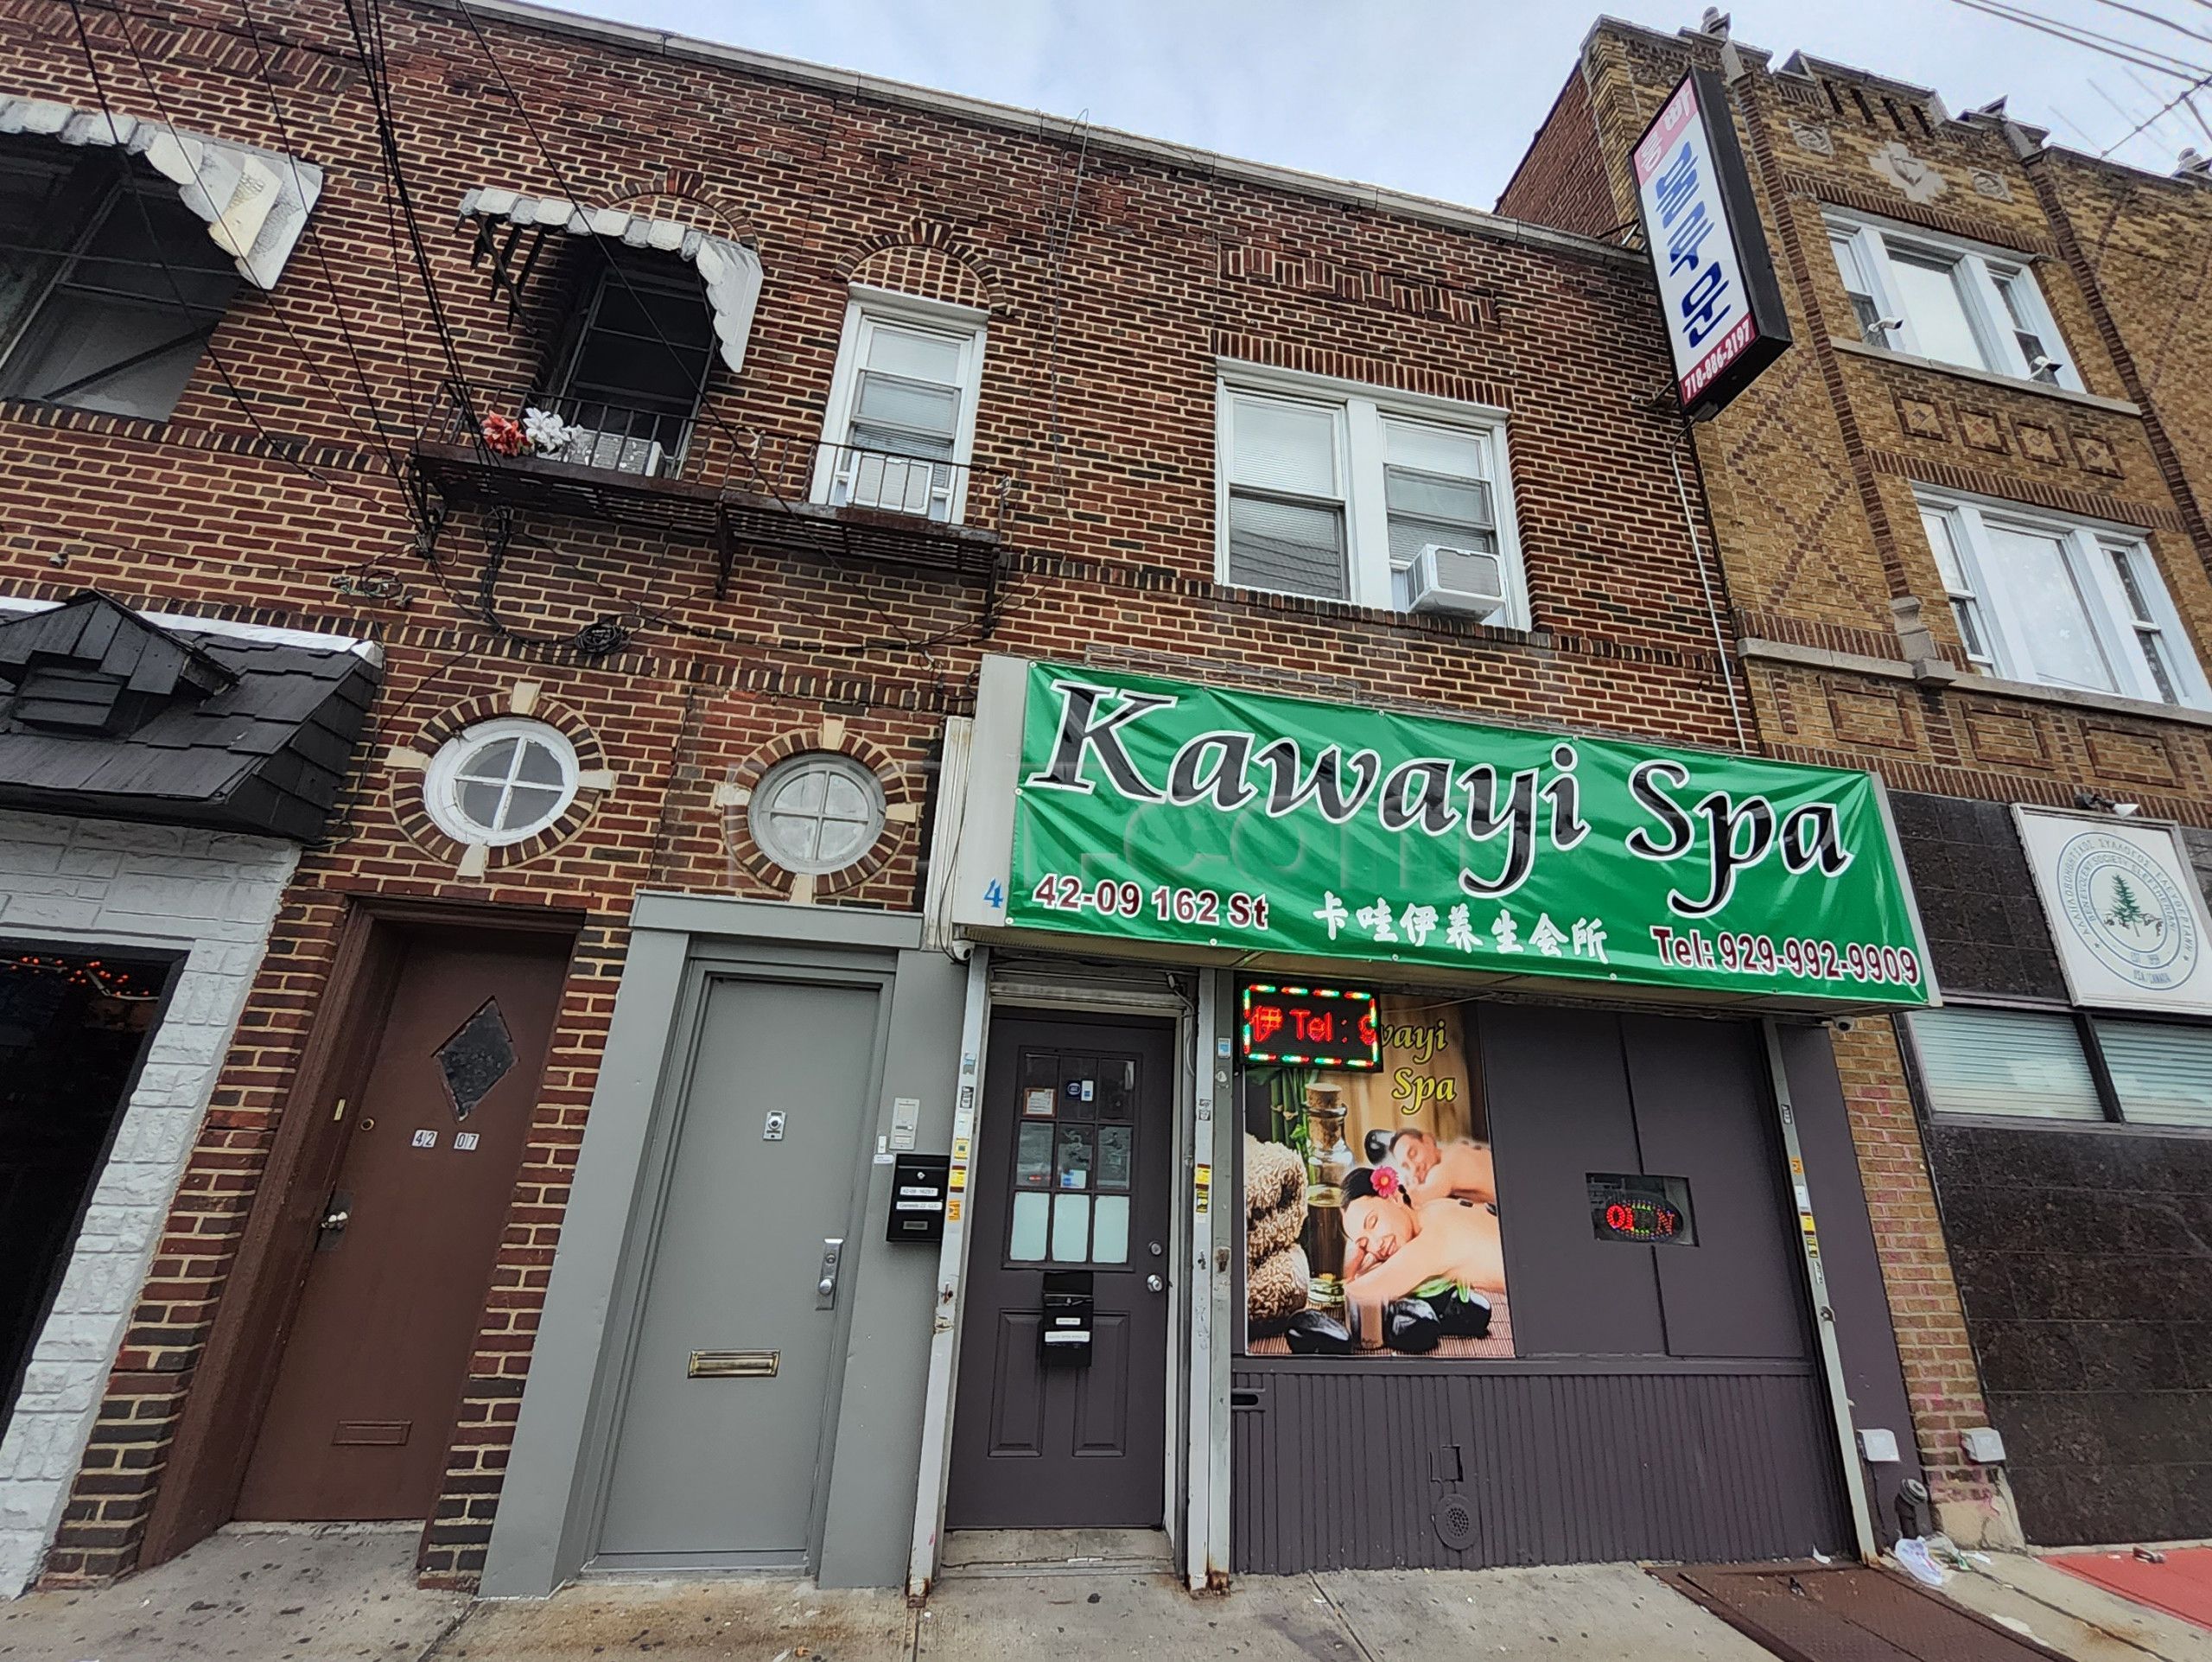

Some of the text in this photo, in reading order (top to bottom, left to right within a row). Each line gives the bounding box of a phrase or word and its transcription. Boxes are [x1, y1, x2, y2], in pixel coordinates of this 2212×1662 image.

[1684, 317, 1751, 399] 718-886-2197
[1026, 678, 1854, 918] Kawayi Spa
[2094, 854, 2128, 867] SOCIETY
[983, 878, 1004, 908] 4
[1033, 874, 1269, 930] 42-09 162 St
[1313, 890, 1609, 965] 卡哇伊养生会所
[1649, 925, 1921, 986] Tel: 929-992-9909
[1392, 1067, 1458, 1116] Spa
